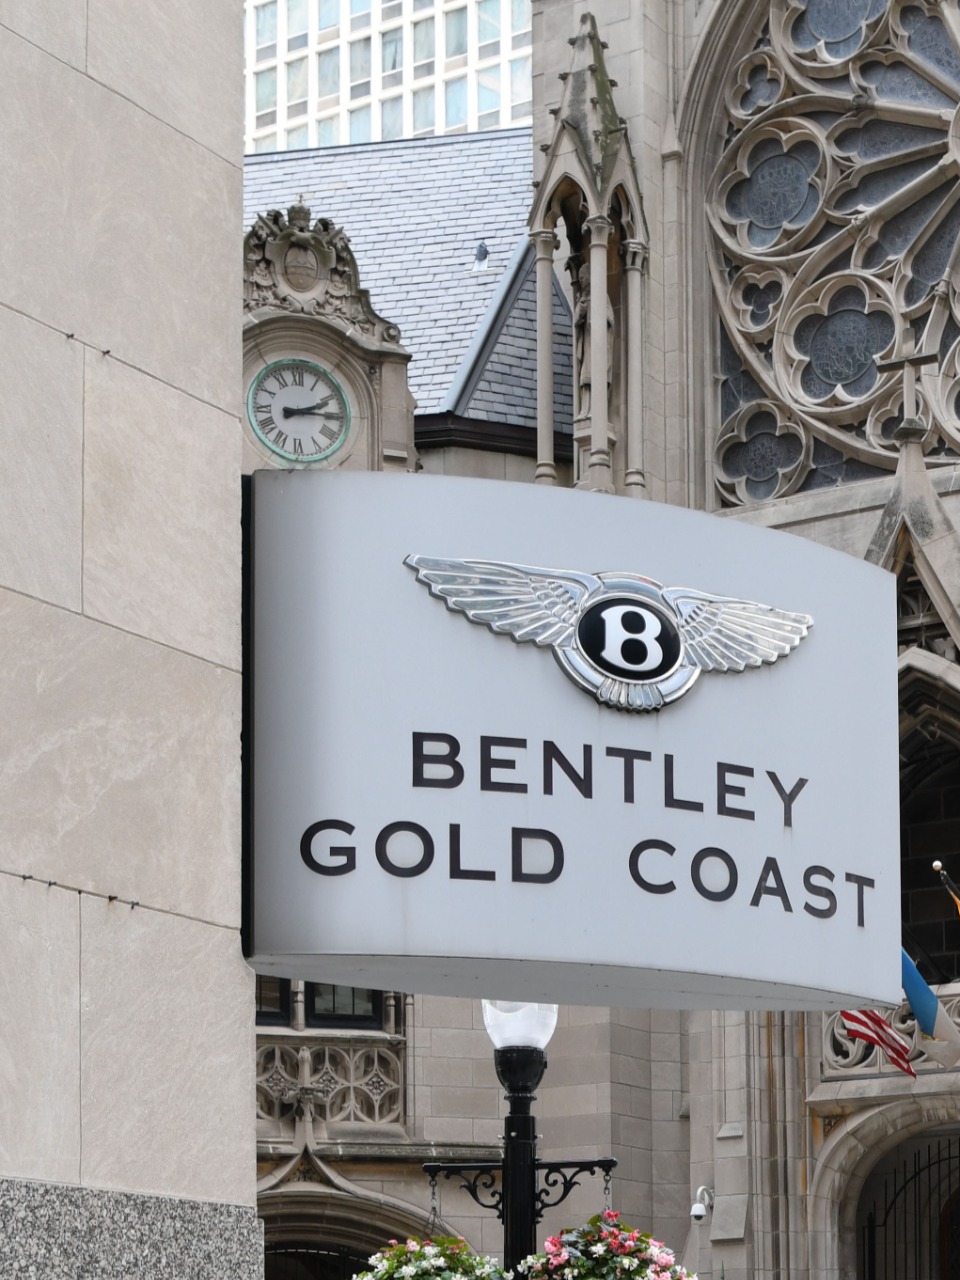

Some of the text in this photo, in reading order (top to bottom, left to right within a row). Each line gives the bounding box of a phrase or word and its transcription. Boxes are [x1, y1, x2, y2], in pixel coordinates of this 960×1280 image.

[601, 604, 662, 672] B
[412, 731, 809, 827] BENTLEY
[300, 819, 875, 928] GOLD COAST
